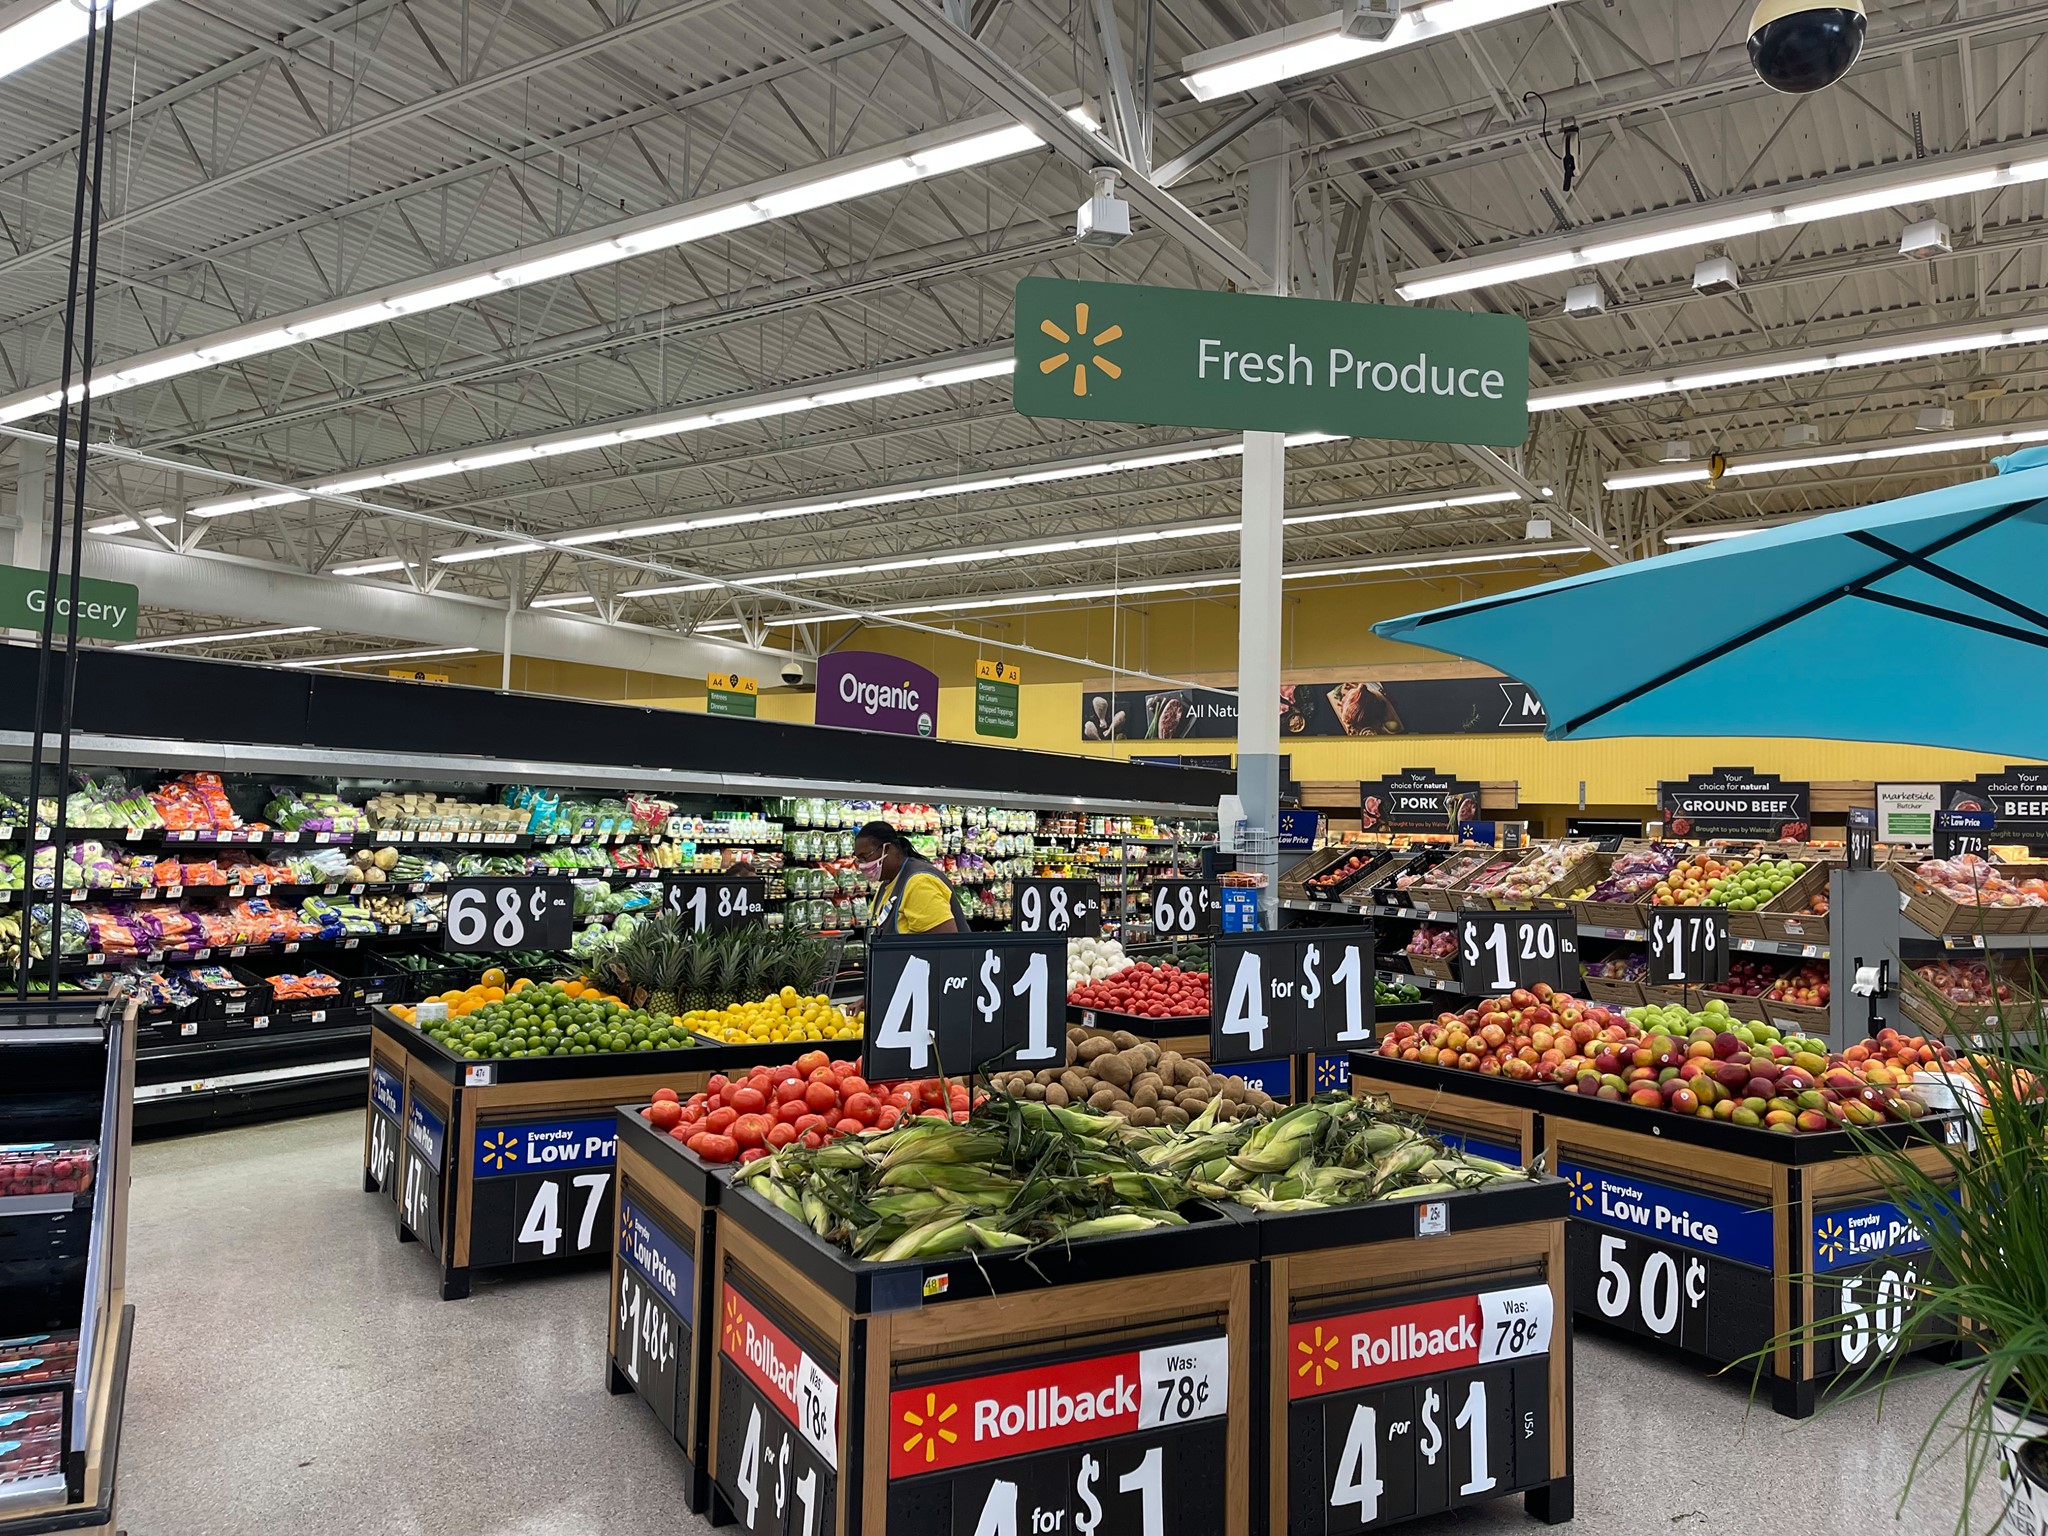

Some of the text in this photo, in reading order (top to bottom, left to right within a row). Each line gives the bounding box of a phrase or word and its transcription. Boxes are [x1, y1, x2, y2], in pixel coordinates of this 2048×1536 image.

[1198, 338, 1505, 399] Fresh Produce
[981, 666, 1017, 681] A2 A3
[712, 678, 754, 691] A4 A5
[839, 672, 920, 715] Organic
[1186, 703, 1239, 719] All Natu
[1390, 782, 1448, 790] choice for natural
[1724, 774, 1743, 782] Your
[2017, 772, 2040, 782] Your
[1698, 782, 1770, 791] choice for natural
[1987, 782, 2018, 791] choice
[2020, 782, 2035, 791] for
[1400, 797, 1439, 809] PORK
[1682, 800, 1788, 813] GROUND BEEF
[1695, 825, 1720, 834] Brought
[1741, 826, 1749, 835] by
[1749, 826, 1775, 834] Walmart
[1991, 831, 2011, 839] ought
[2036, 831, 2045, 839] by
[1292, 836, 1309, 844] Price
[749, 903, 764, 913] ea.
[1088, 899, 1099, 910] lb.
[1211, 900, 1223, 909] ea.
[1562, 938, 1577, 953] lb.
[1221, 950, 1269, 1052] 4
[1271, 978, 1294, 999] for
[875, 954, 935, 1071] 4
[1243, 1076, 1264, 1091] ice
[377, 1081, 397, 1114] Low Price
[413, 1118, 434, 1156] Low Price
[527, 1130, 574, 1142] Everyday
[527, 1134, 619, 1164] Low Pri
[1600, 1180, 1643, 1201] Everyday
[1601, 1193, 1719, 1245] Low Price
[1848, 1214, 1880, 1229] Everyday
[634, 1218, 651, 1243] Everyday
[1849, 1218, 1930, 1255] Low Pric
[633, 1231, 676, 1297] Low Price
[1502, 1300, 1529, 1315] Was:
[1351, 1315, 1477, 1369] Rollback
[1496, 1317, 1538, 1356] 78¢
[1166, 1356, 1198, 1372] Was:
[809, 1365, 823, 1394] Was:
[1157, 1374, 1210, 1422] 78¢
[803, 1385, 828, 1441] 78¢
[974, 1374, 1138, 1442] Rollback
[1523, 1411, 1535, 1439] USA
[737, 1402, 762, 1531] 4
[1330, 1404, 1384, 1524] 4
[1388, 1420, 1411, 1441] for
[1032, 1508, 1065, 1535] for
